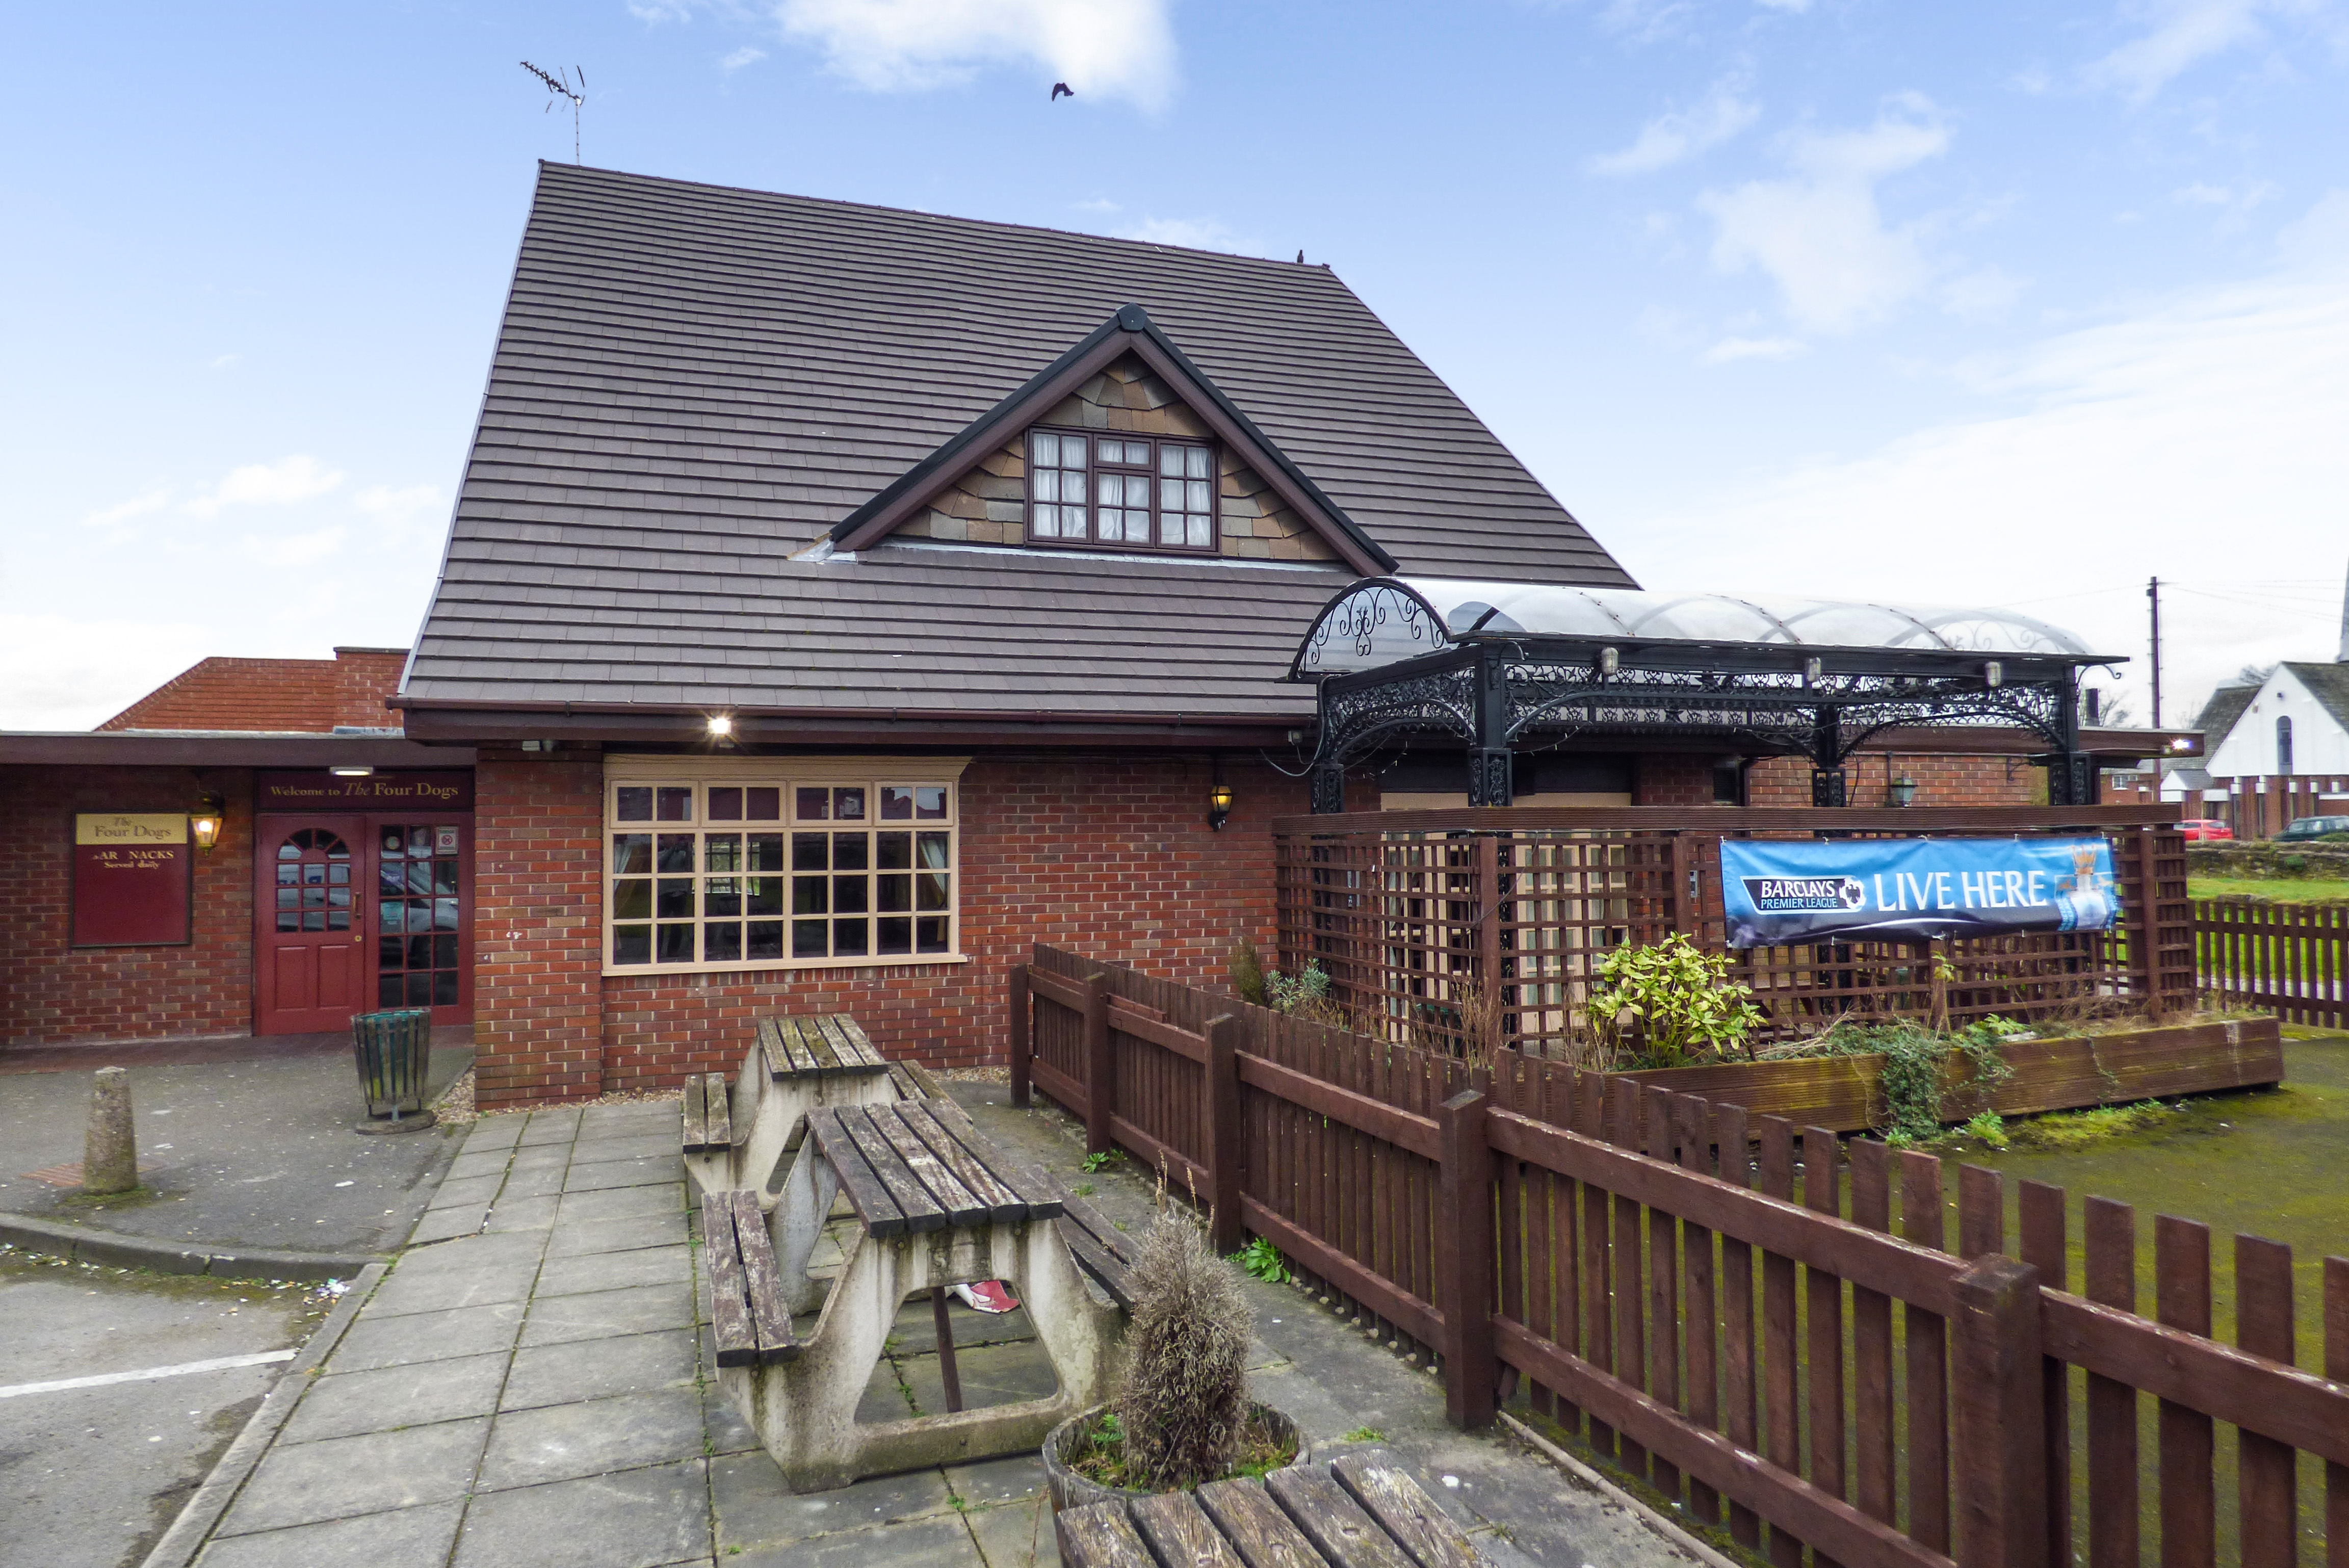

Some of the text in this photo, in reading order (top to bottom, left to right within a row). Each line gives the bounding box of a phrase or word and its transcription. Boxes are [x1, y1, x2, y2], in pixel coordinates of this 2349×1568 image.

[271, 786, 324, 796] Welcome
[346, 782, 371, 796] The
[375, 783, 412, 796] Four
[416, 782, 458, 799] Dogs
[94, 825, 171, 840] Four Dogs
[1761, 880, 1836, 898] BARCLAYS
[1874, 870, 2048, 911] LIVE HERE
[1761, 898, 1838, 909] PREMIER LEAGUE
